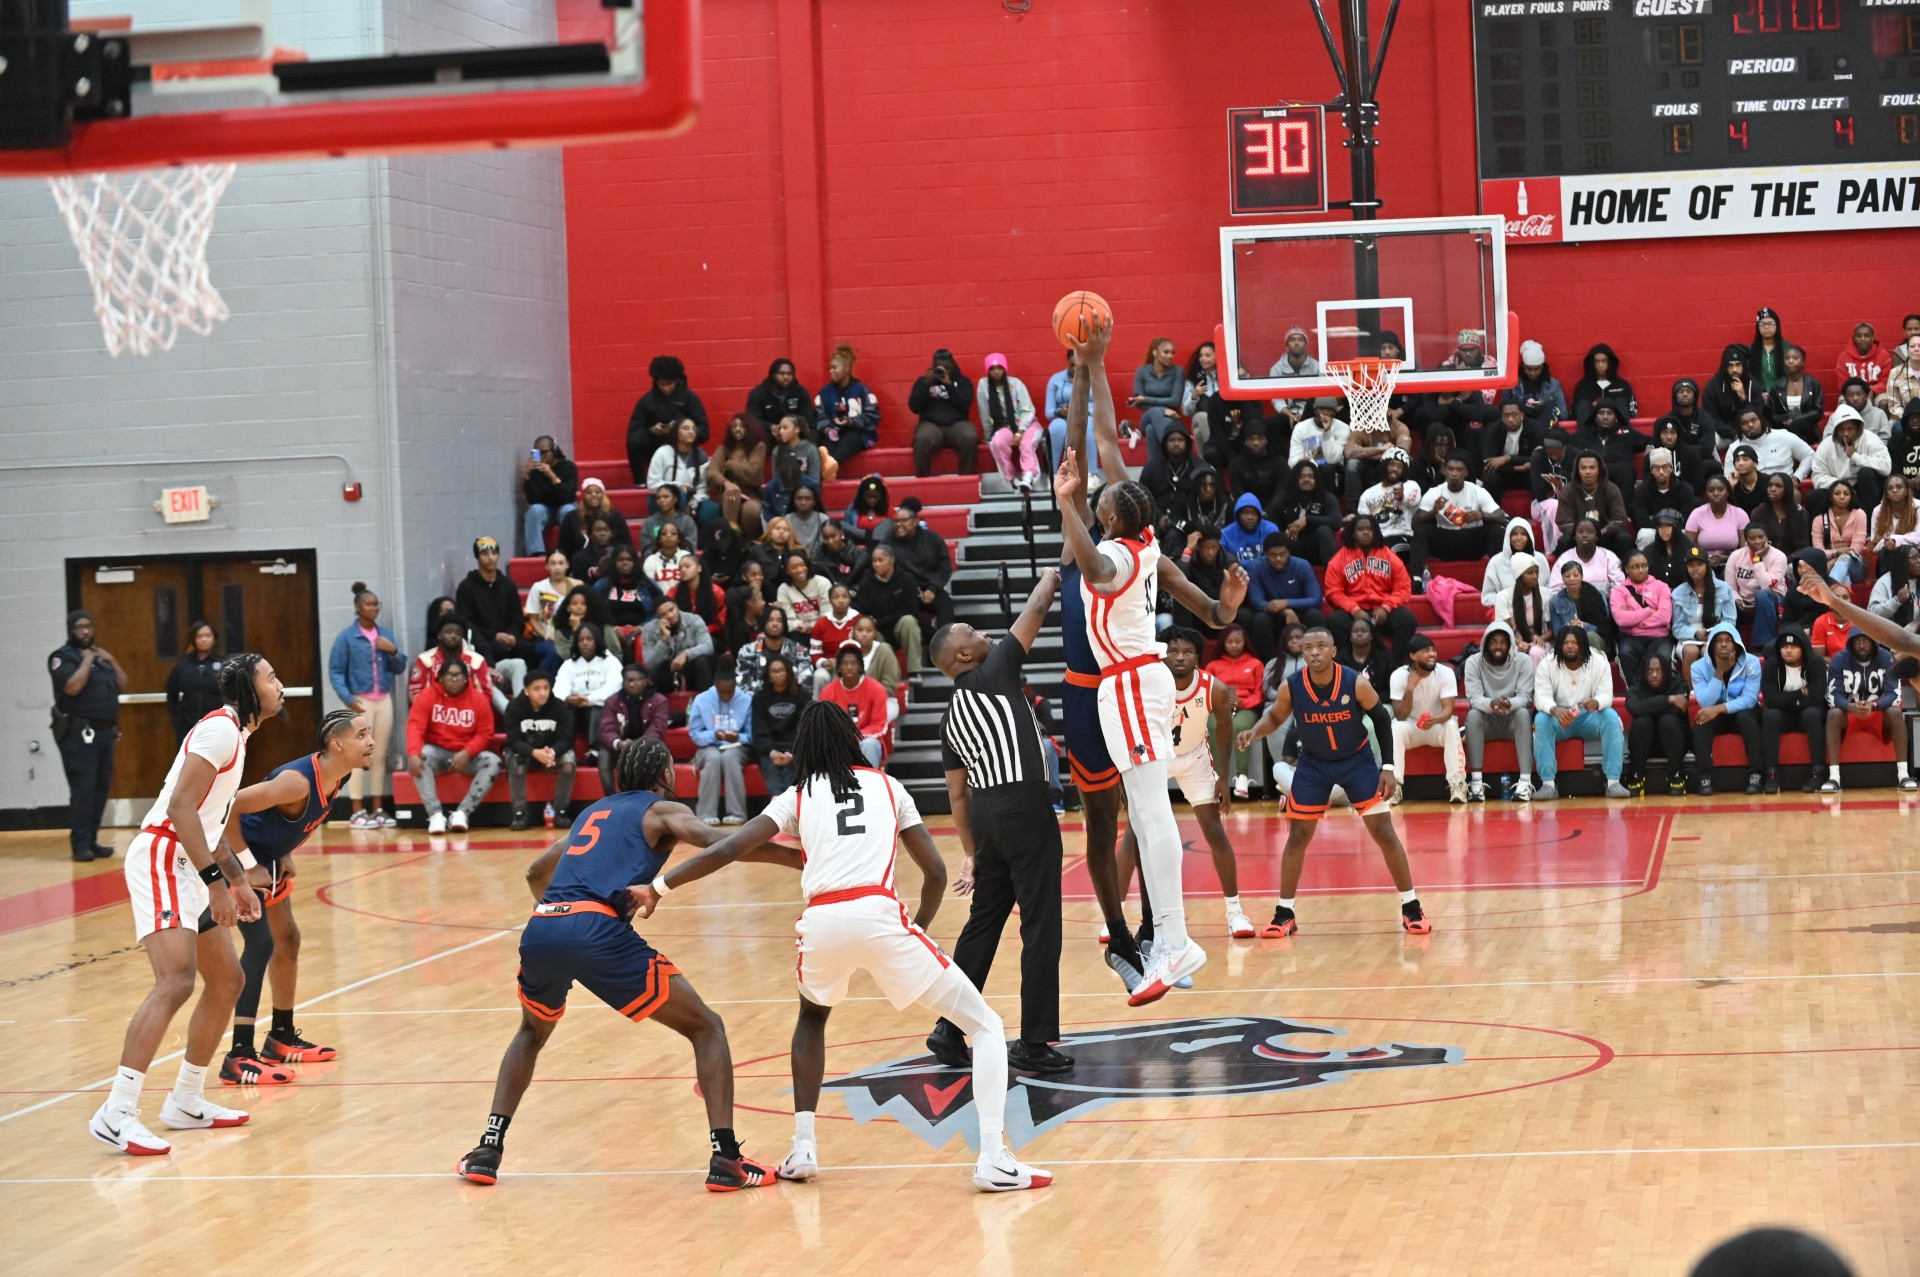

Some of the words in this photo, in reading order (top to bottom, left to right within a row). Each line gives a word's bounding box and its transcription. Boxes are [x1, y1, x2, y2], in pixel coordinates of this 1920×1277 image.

[1484, 4, 1525, 16] PLAYER
[1530, 2, 1565, 14] FOULS
[1572, 0, 1610, 12] POINTS
[1635, 0, 1707, 16] GUEST
[1730, 57, 1796, 75] PERIOD
[1655, 103, 1699, 116] FOULS
[1736, 100, 1767, 112] TIME
[1773, 99, 1806, 111] OUTS
[1811, 97, 1845, 109] LEFT
[1729, 120, 1748, 150] 4
[1835, 116, 1854, 146] 4
[1243, 121, 1310, 175] 30
[1570, 187, 1671, 226] HOME
[1688, 184, 1734, 221] OF
[1750, 181, 1819, 217] THE
[1505, 214, 1556, 237] ca-Cola
[170, 489, 200, 513] EXIT
[1304, 709, 1352, 723] LAKERS
[1326, 726, 1337, 750] 1
[834, 792, 866, 836] 2
[565, 809, 612, 856] 5
